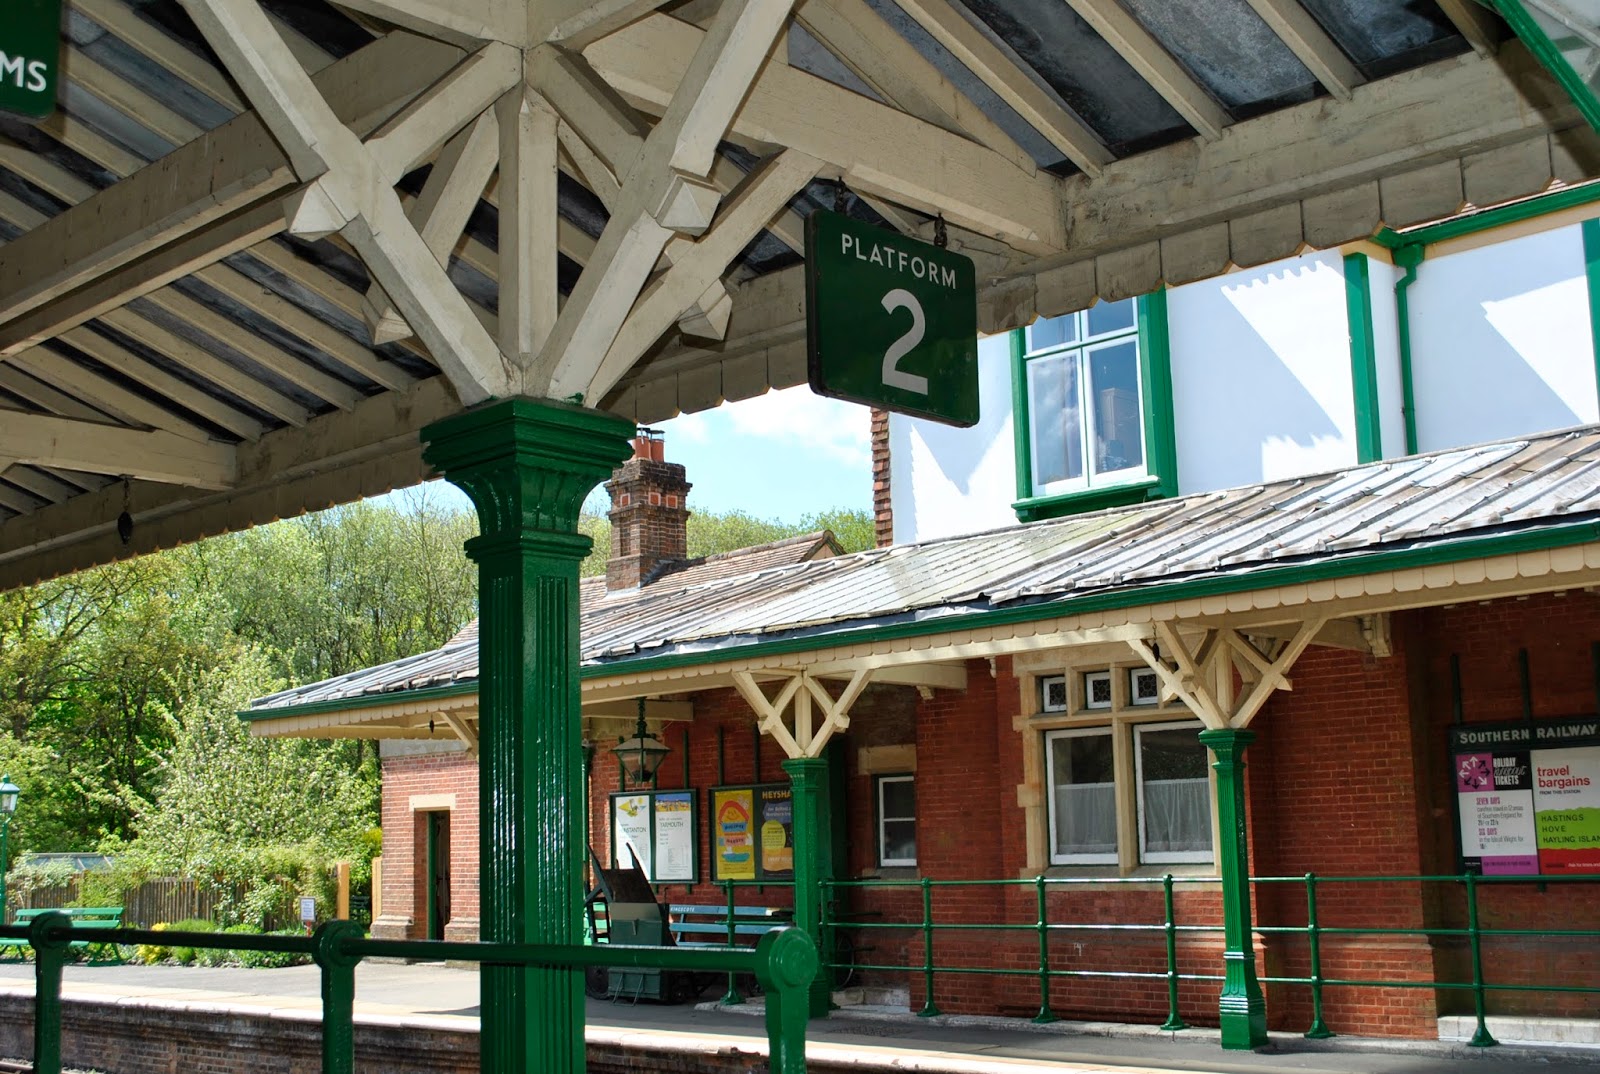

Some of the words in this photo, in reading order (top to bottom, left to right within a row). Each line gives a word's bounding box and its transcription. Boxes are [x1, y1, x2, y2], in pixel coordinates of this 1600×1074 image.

[841, 233, 956, 290] PLATFORM
[881, 288, 928, 396] 2
[1460, 729, 1530, 744] SOUTHERN
[1536, 724, 1597, 739] RAILWAY
[1537, 765, 1569, 776] travel
[1495, 775, 1519, 786] TICKETS
[1538, 776, 1590, 789] bargains
[1541, 814, 1584, 822] HASTINGS
[1542, 825, 1566, 833] HOVE
[1543, 835, 1575, 844] HAYLING
